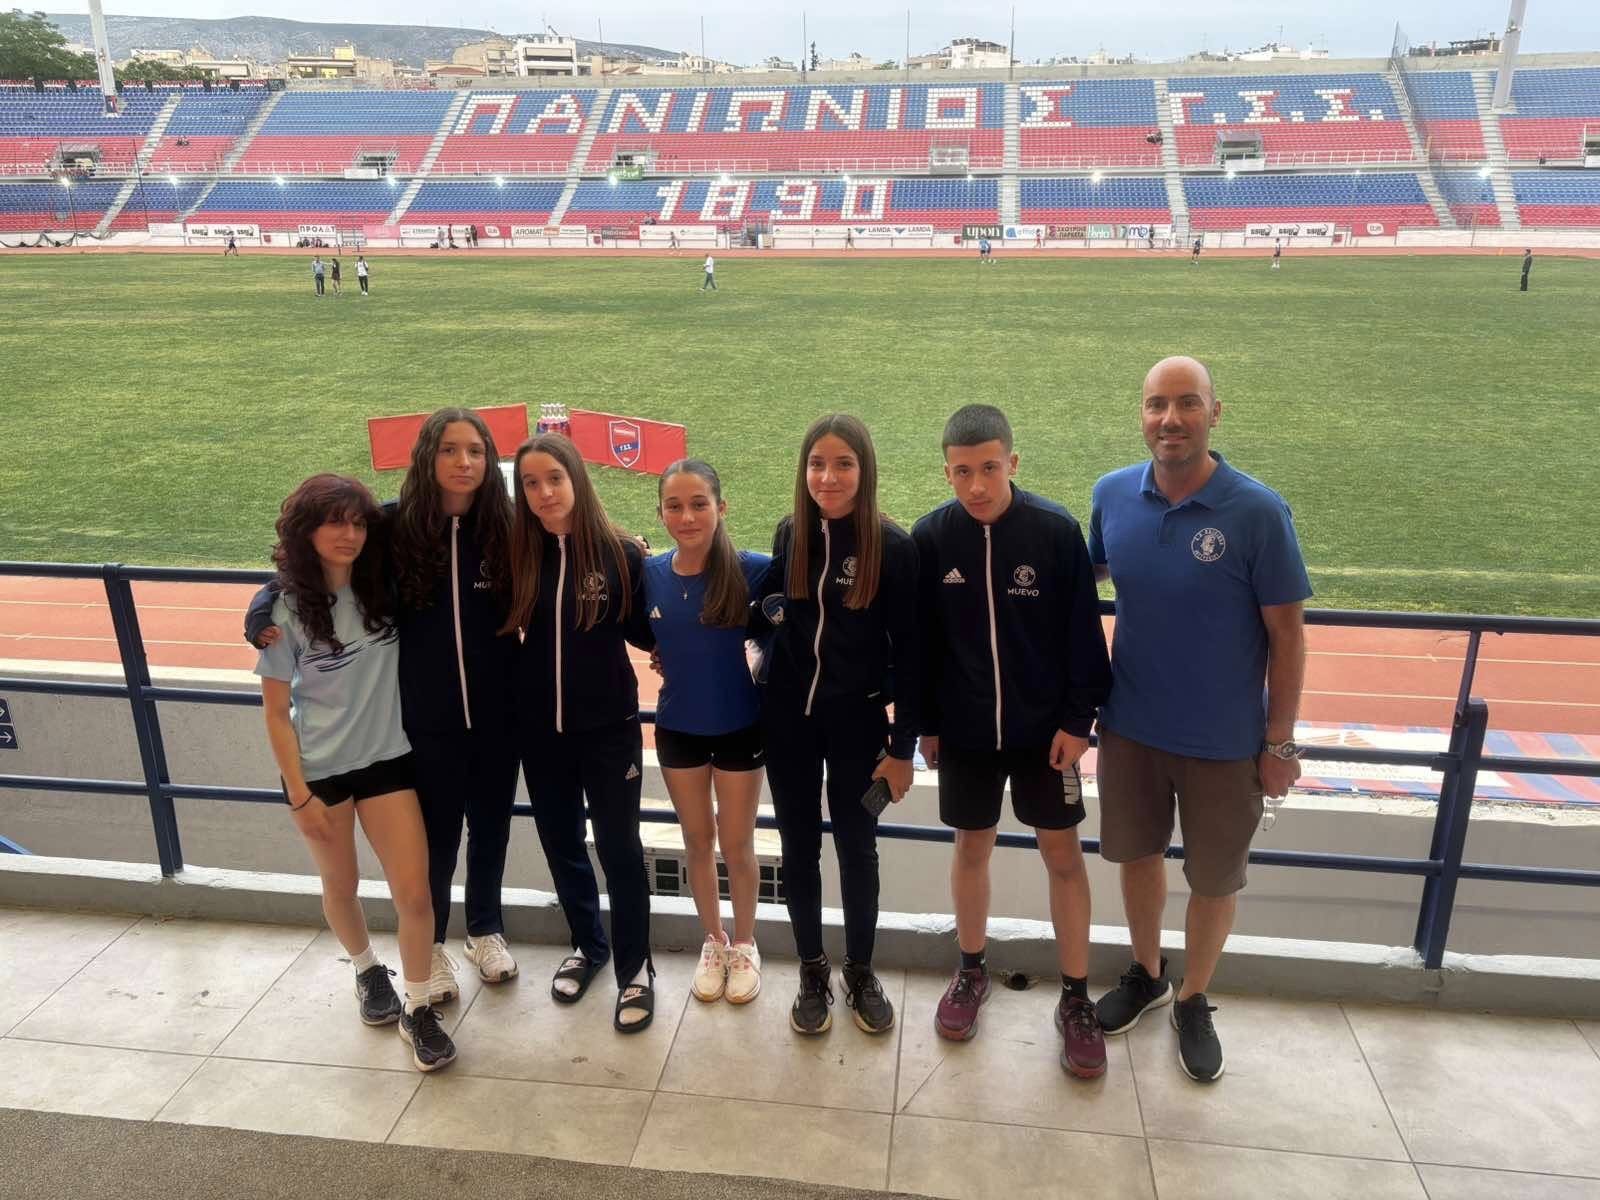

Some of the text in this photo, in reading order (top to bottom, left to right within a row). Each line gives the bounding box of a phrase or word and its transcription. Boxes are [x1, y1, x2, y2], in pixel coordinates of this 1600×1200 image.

[453, 85, 1073, 134] ΠΑΝΙΩΝΙΟΣ
[656, 178, 890, 221] 1890
[1007, 588, 1040, 597] MUEVO
